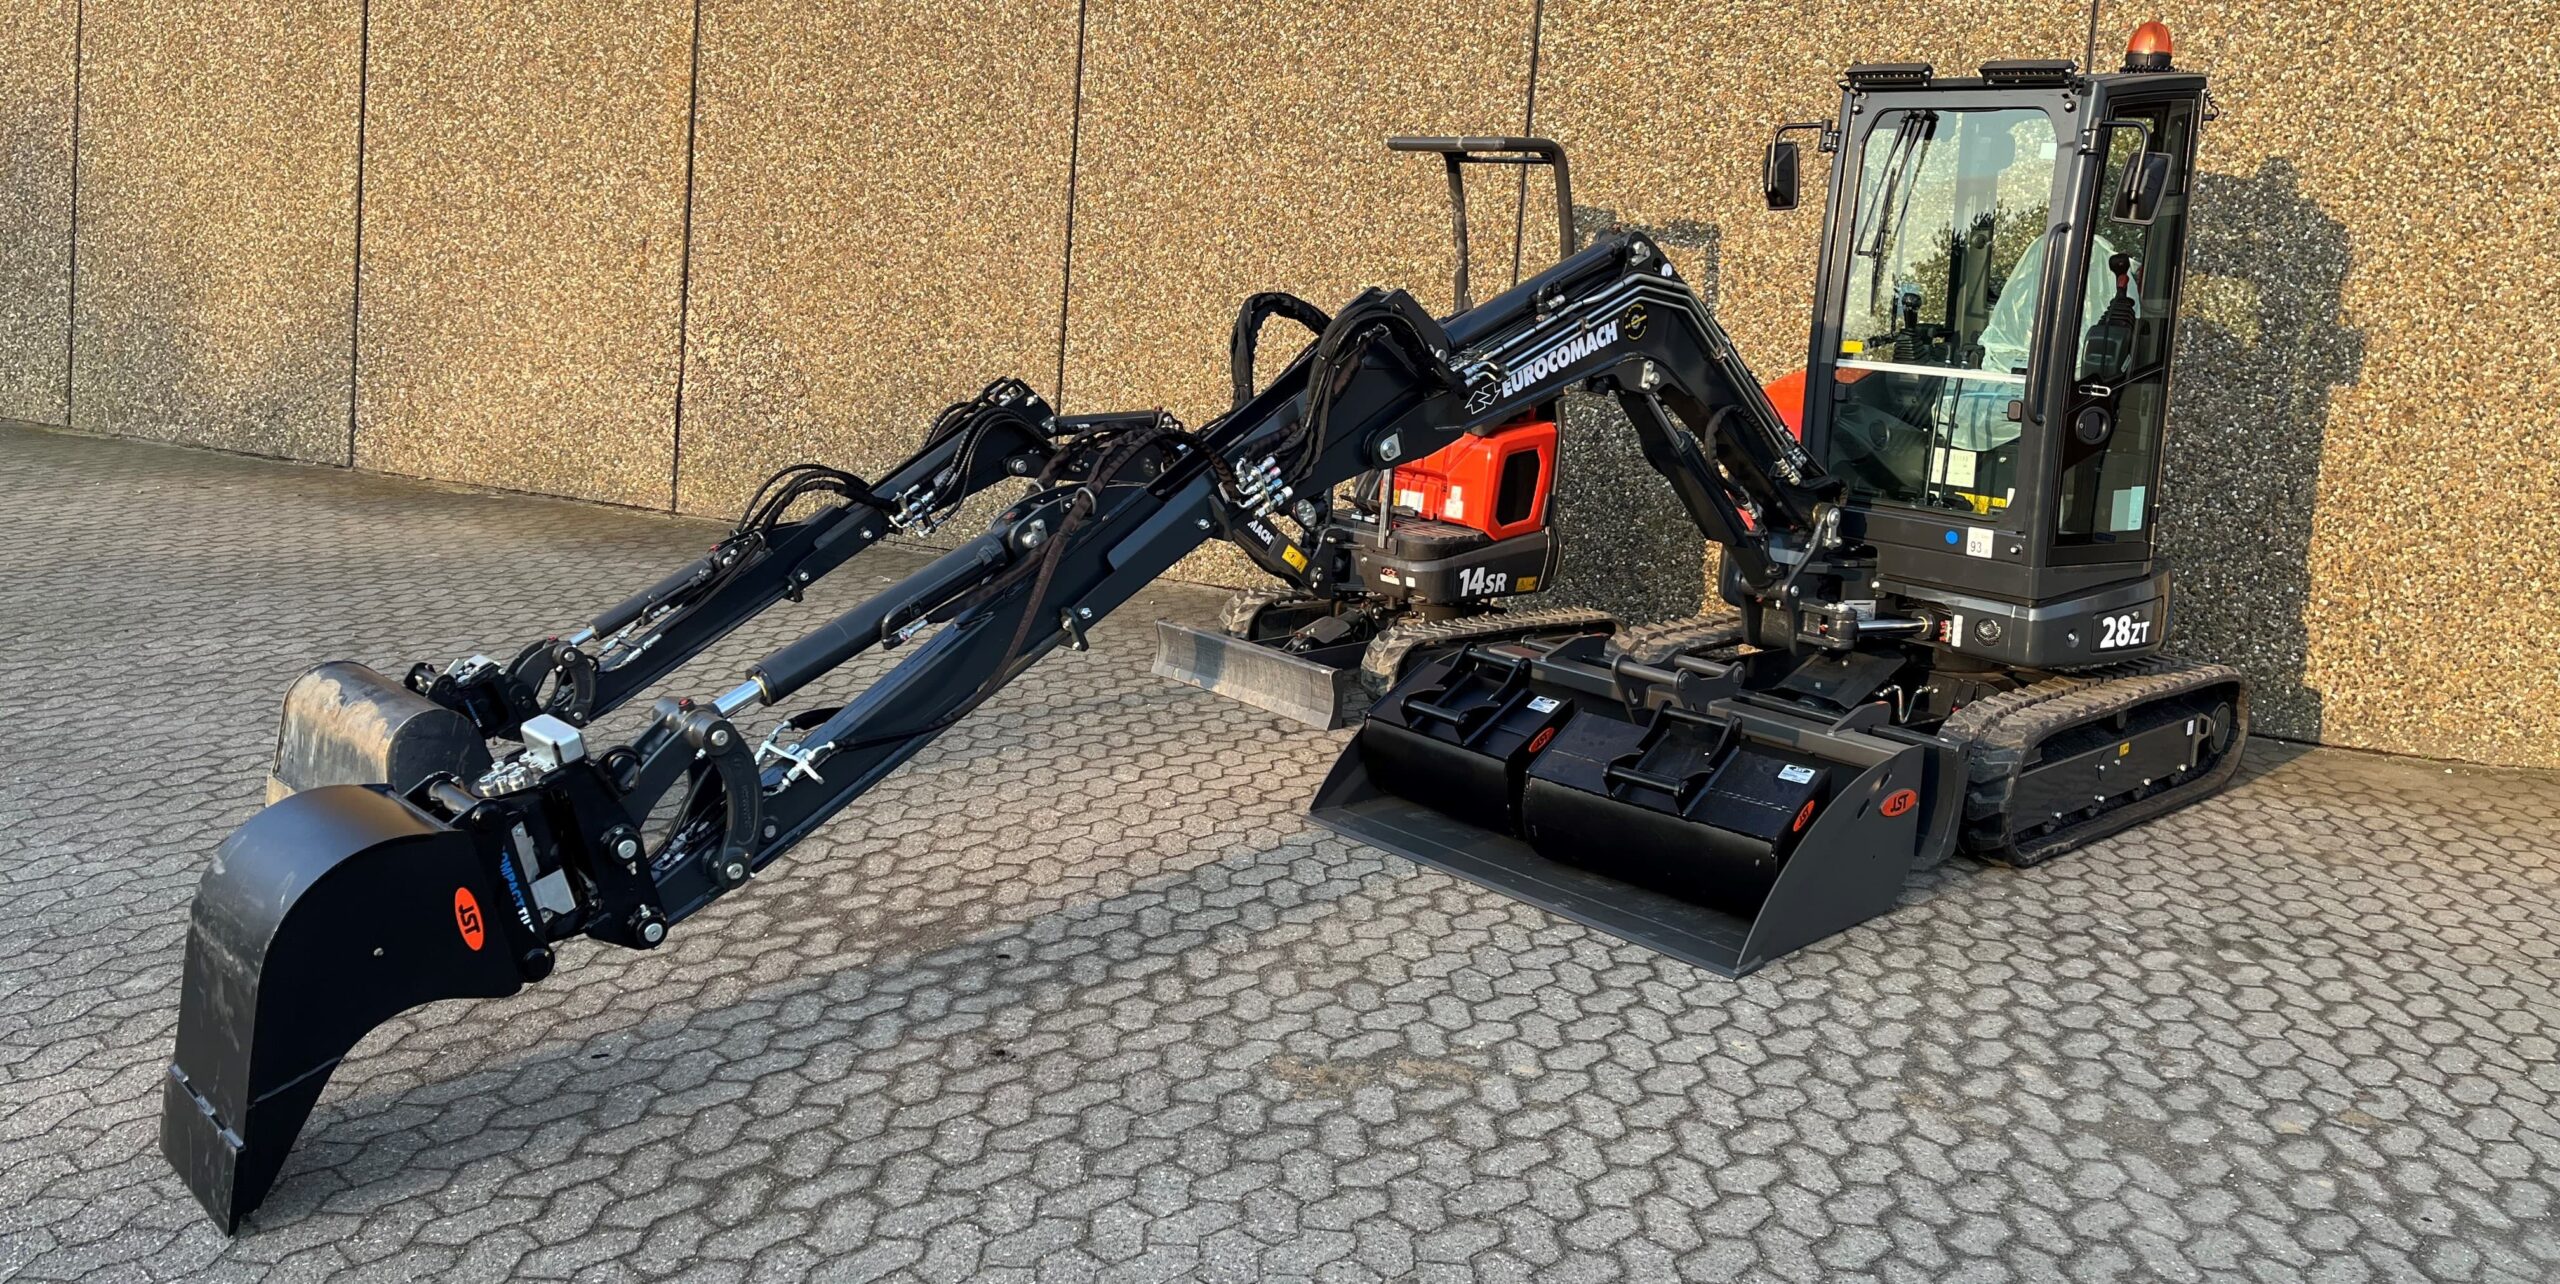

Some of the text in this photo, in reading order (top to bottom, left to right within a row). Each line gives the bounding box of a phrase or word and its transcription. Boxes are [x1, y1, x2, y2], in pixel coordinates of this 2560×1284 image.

[1502, 321, 1617, 397] EUROCOMACH
[1460, 567, 1507, 597] 14SR
[2100, 615, 2149, 648] 28ZT
[1890, 793, 1909, 812] JST
[458, 904, 480, 934] JST
